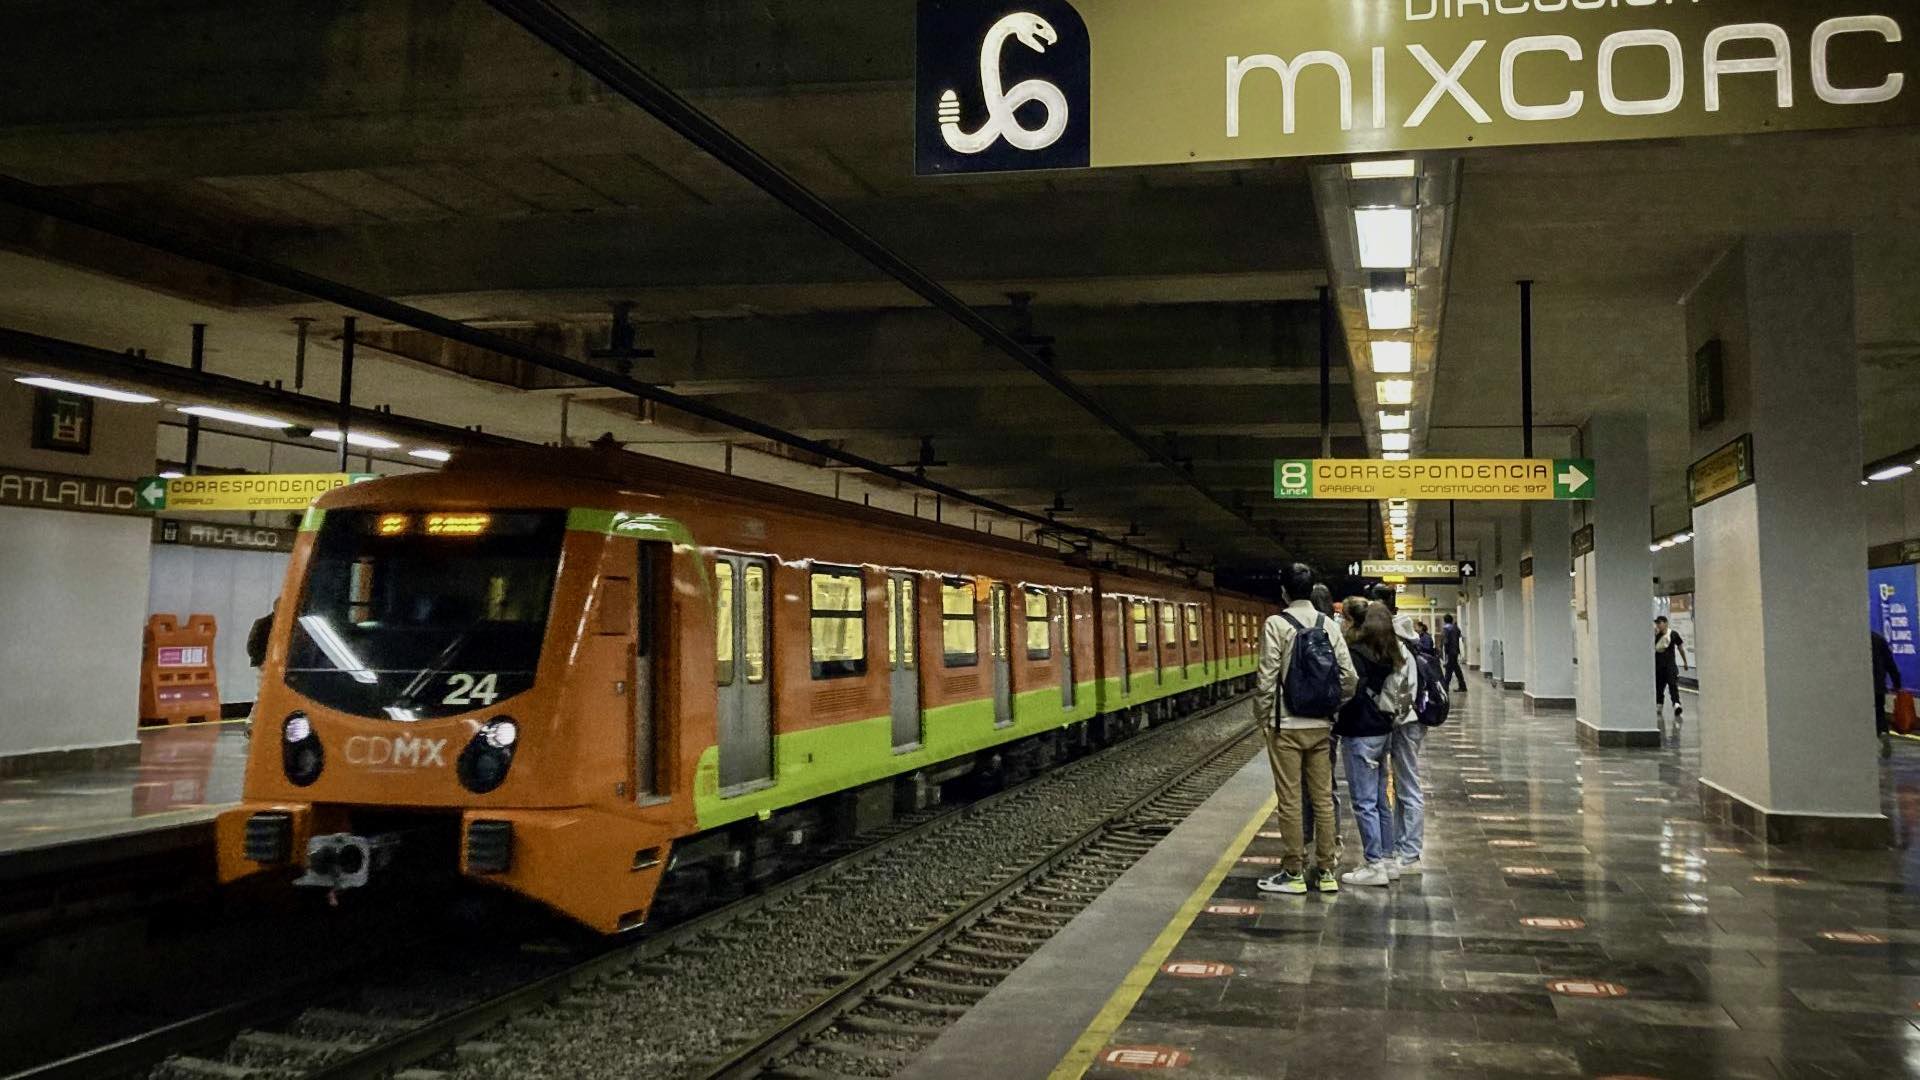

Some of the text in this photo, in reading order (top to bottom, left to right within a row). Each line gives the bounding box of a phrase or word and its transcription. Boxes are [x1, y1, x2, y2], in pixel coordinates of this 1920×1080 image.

[1226, 14, 1904, 138] MIXCOAC
[1281, 462, 1307, 488] 8
[1318, 465, 1547, 479] CORRESPONDENCIA
[0, 475, 139, 509] ATLALILC
[1319, 484, 1375, 493] GARIBALDI
[1420, 484, 1547, 493] CONSTITUCION DE 1917
[1362, 563, 1458, 573] MUJERES Y NIÑOS
[442, 673, 499, 705] 24
[345, 735, 447, 767] CDMX
